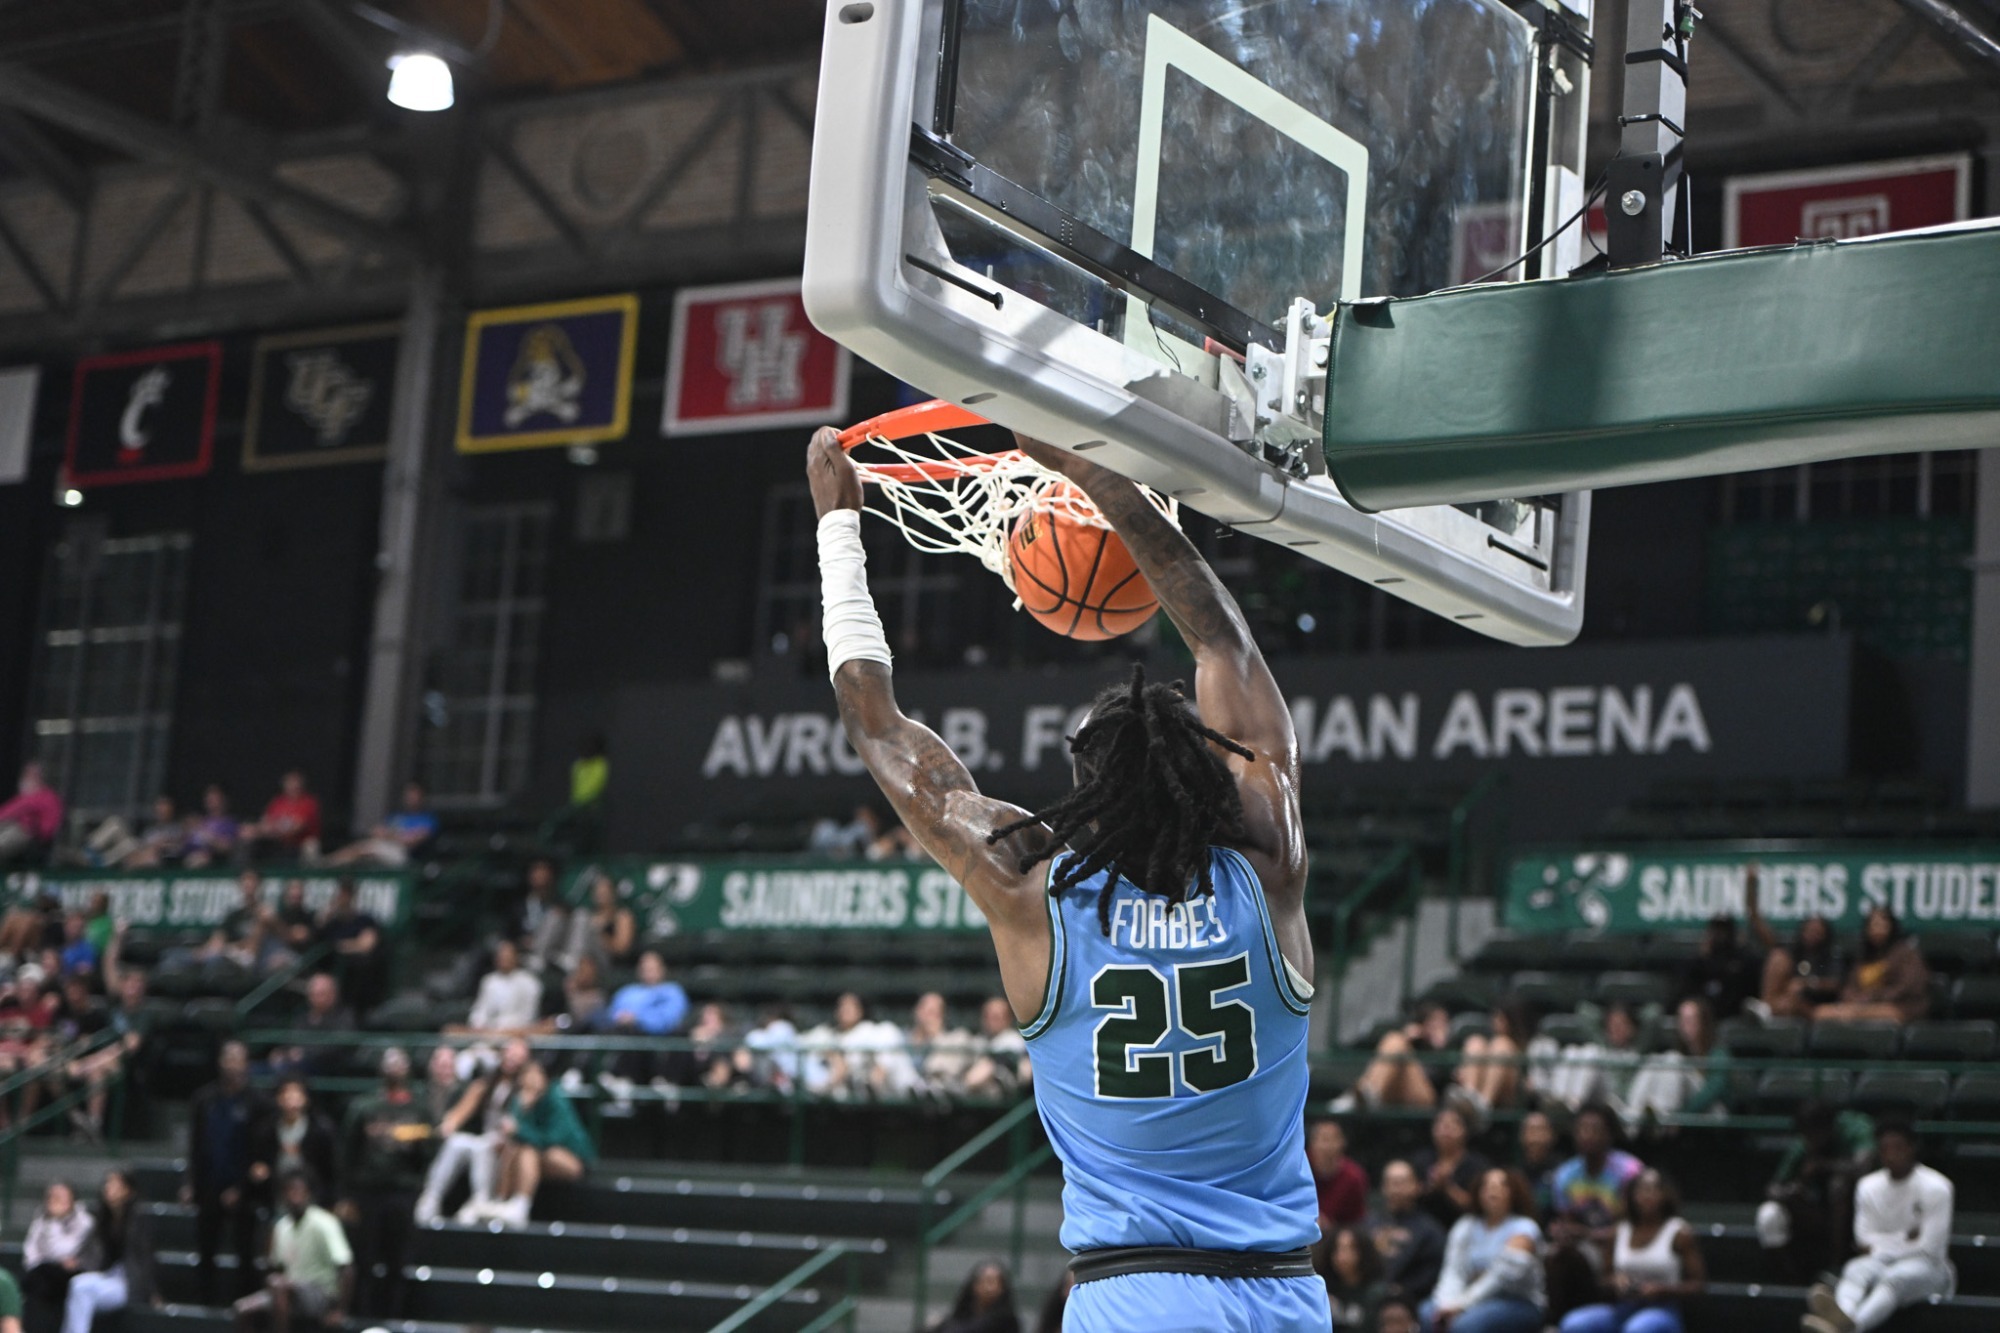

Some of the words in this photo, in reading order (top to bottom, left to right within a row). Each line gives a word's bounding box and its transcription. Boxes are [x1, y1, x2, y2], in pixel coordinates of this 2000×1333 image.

[703, 712, 924, 778] AVRO
[942, 707, 1003, 770] B.
[1432, 684, 1713, 760] ARENA
[720, 869, 909, 928] SAUNDERS
[1637, 863, 1848, 922] SAUNDERS
[1860, 863, 2000, 920] STUDE
[1111, 899, 1227, 949] FORBES
[1090, 950, 1259, 1099] 25
